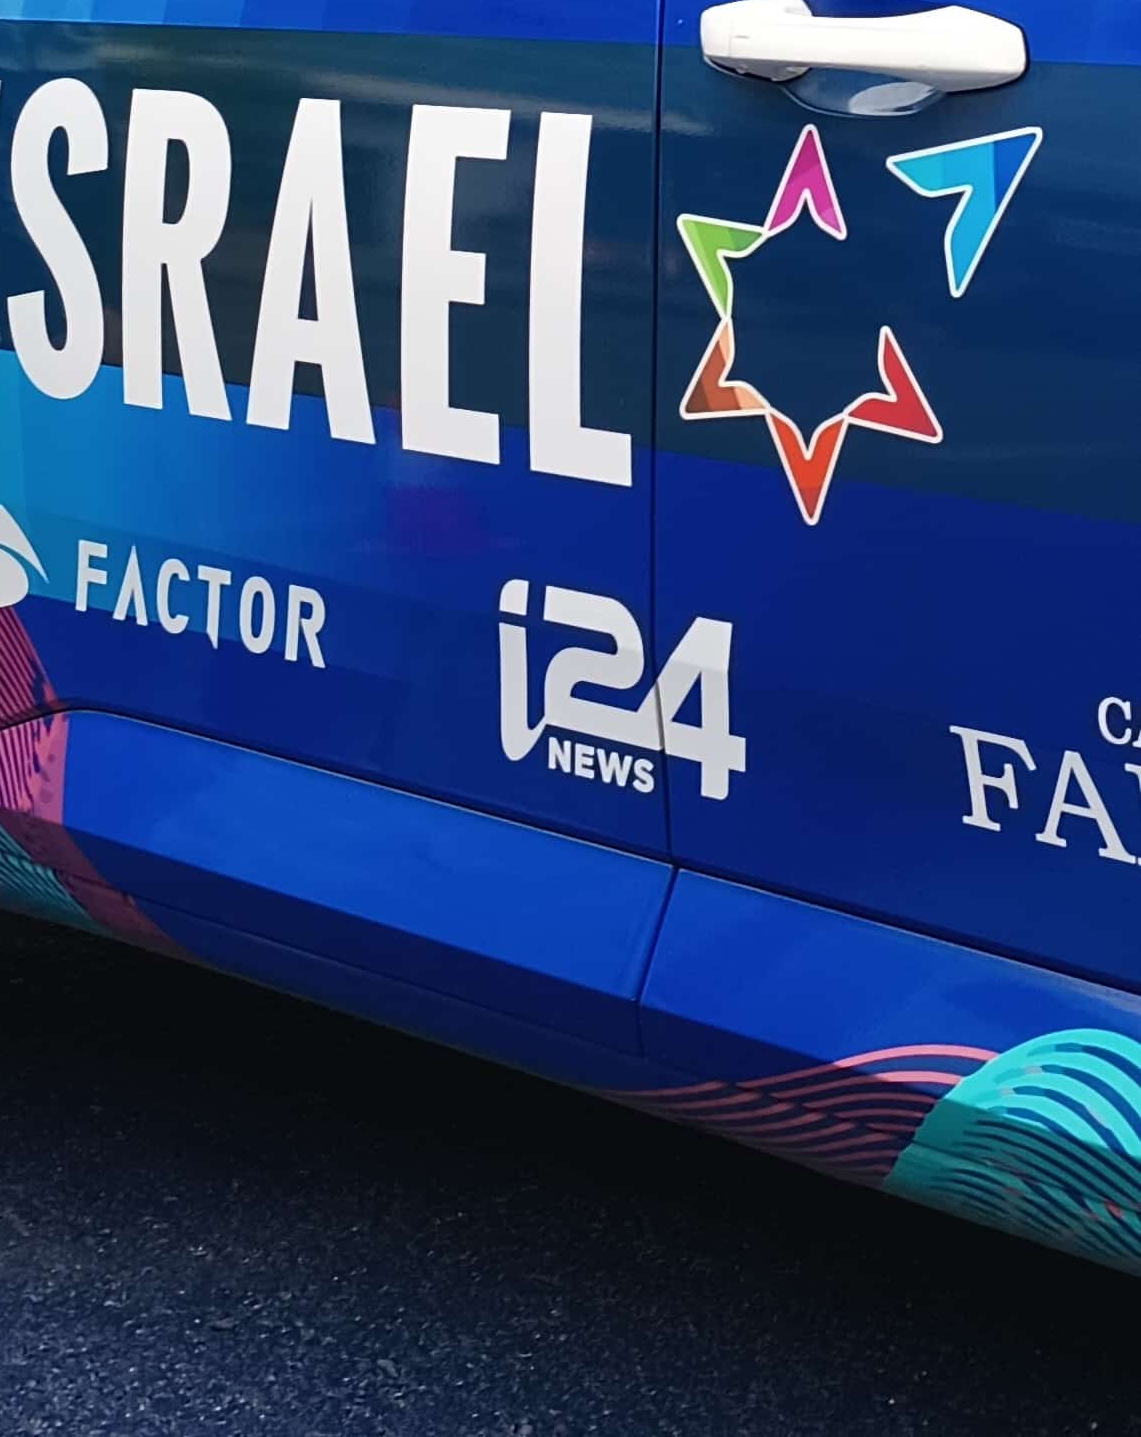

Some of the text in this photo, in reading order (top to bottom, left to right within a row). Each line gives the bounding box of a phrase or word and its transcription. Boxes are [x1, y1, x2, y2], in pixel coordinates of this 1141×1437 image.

[75, 539, 326, 669] FACTOR
[499, 579, 746, 800] i24
[1097, 696, 1141, 749] C
[548, 737, 655, 793] NEWS
[949, 725, 1141, 866] FA
